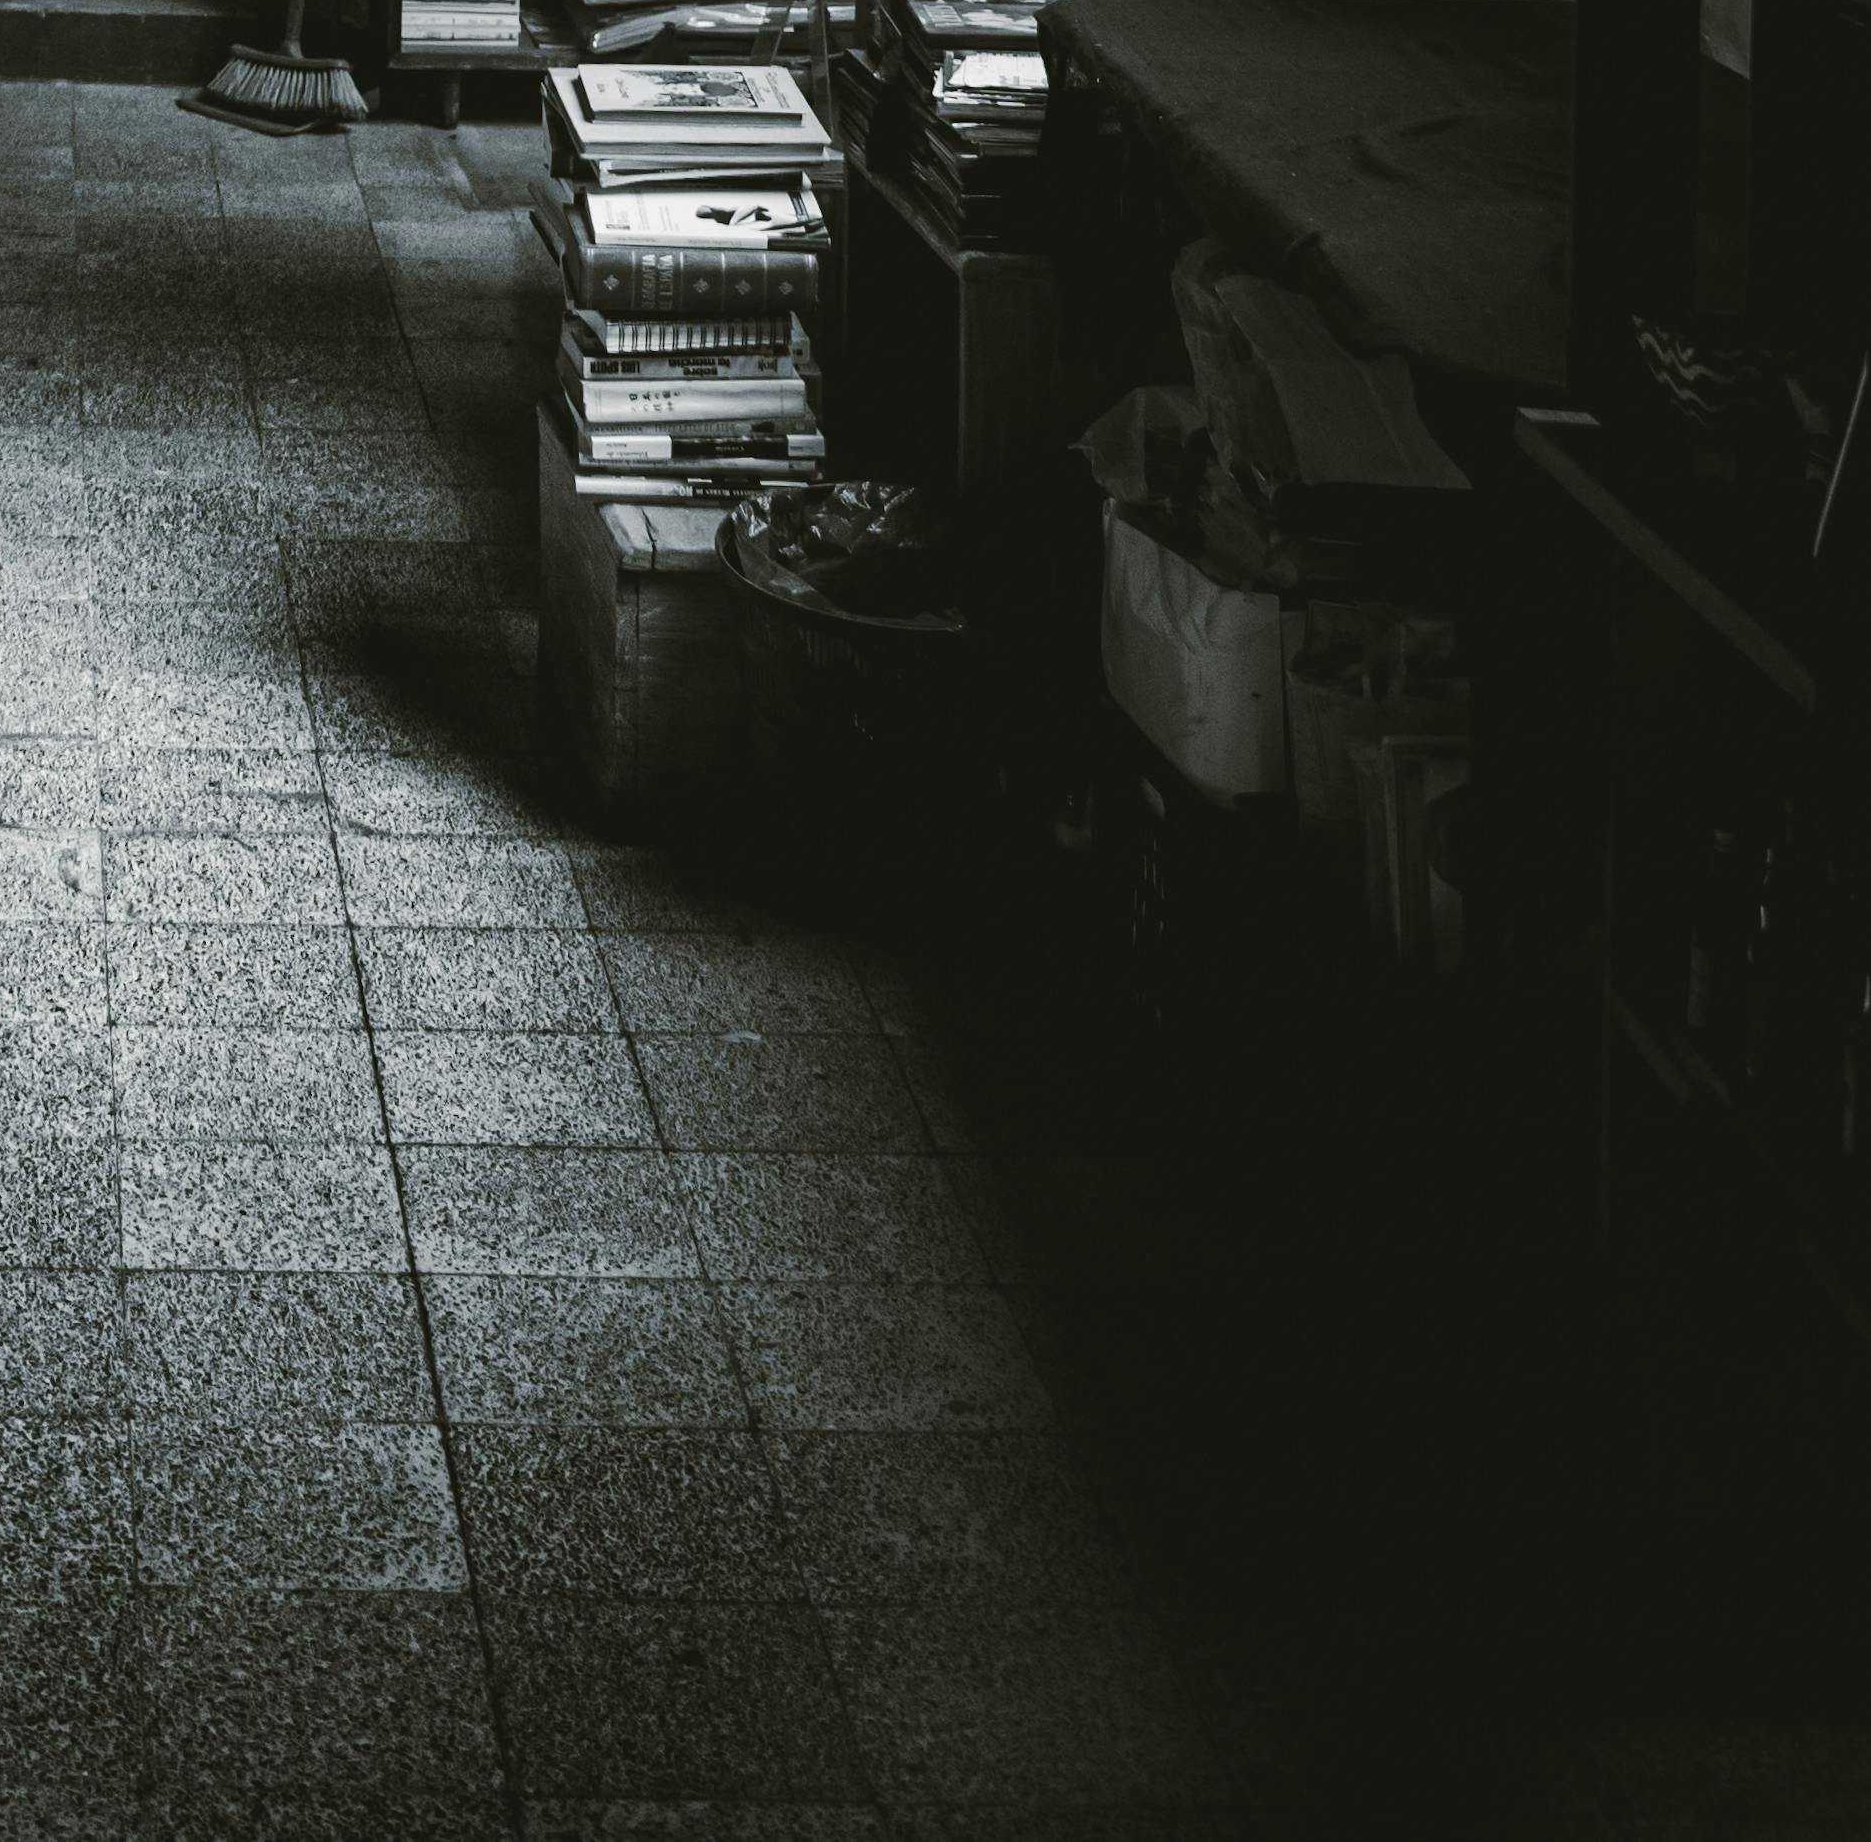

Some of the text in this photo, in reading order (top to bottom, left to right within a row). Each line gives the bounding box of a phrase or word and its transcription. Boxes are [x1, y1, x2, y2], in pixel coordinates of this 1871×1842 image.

[588, 361, 641, 375] LUIS SPOTA
[668, 356, 731, 368] la marcha
[683, 365, 718, 377] sobre
